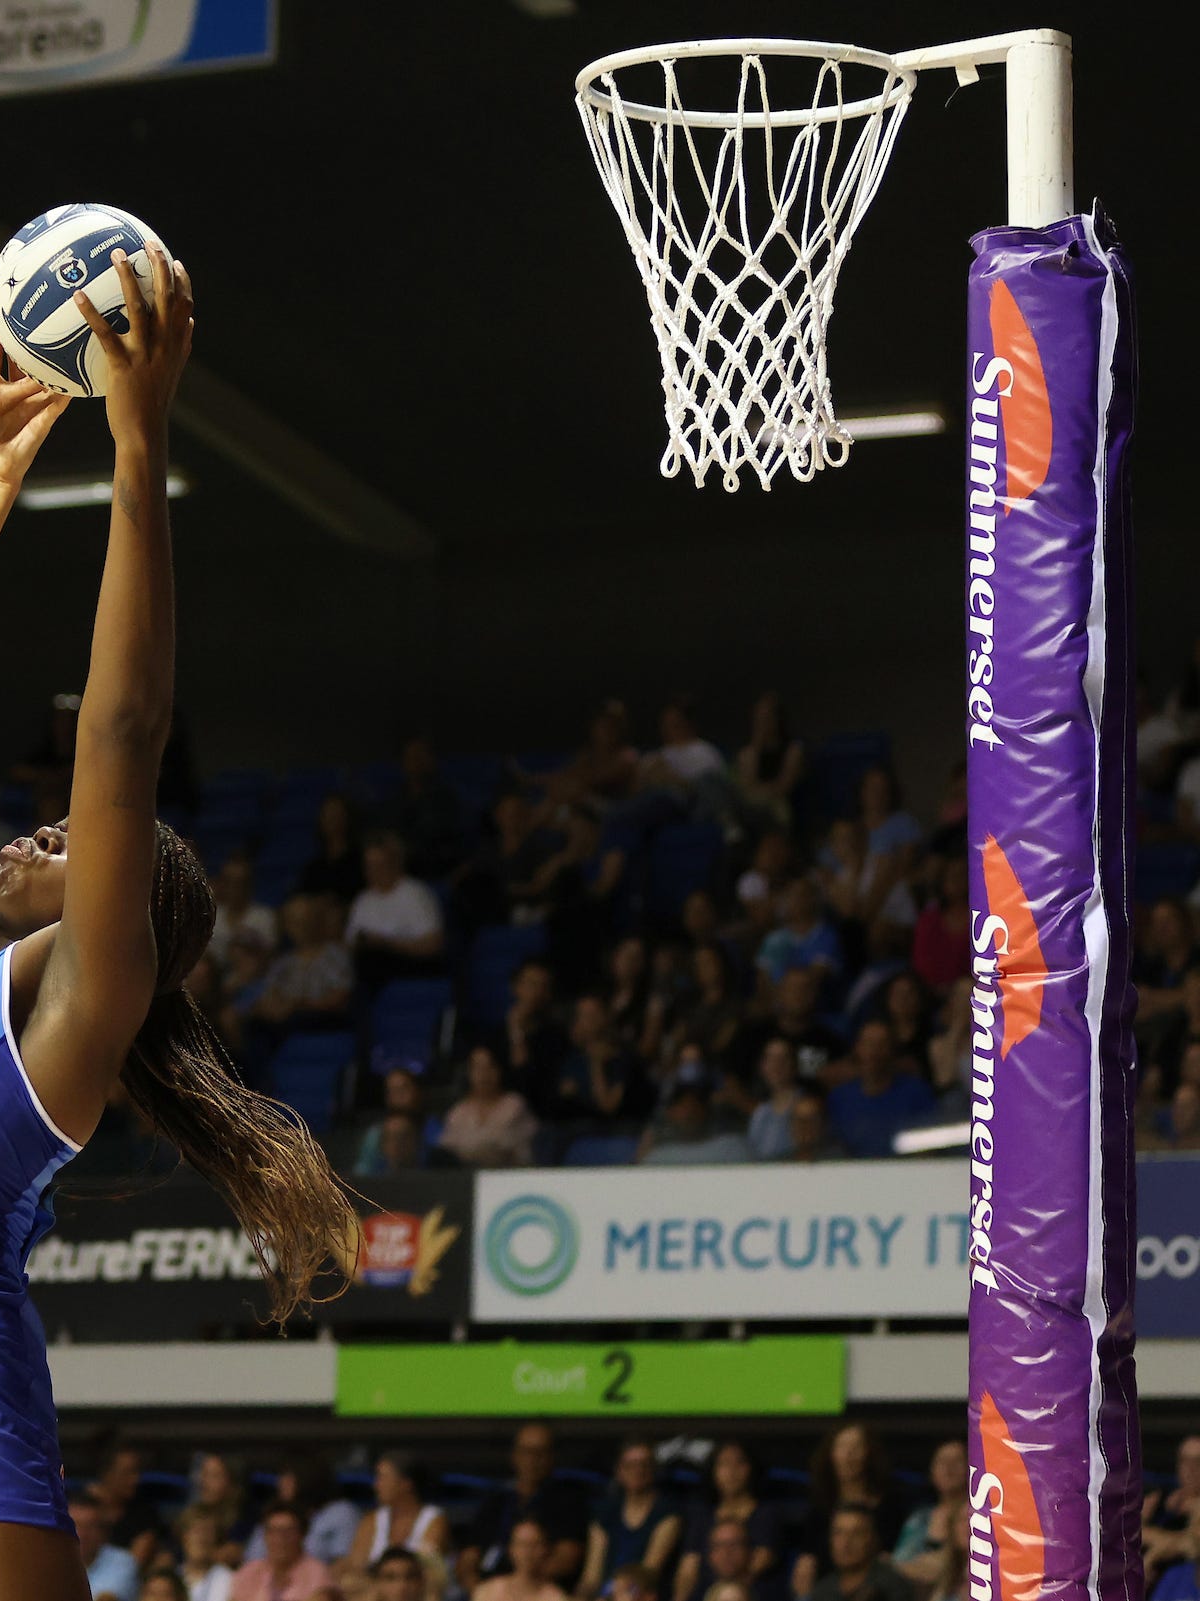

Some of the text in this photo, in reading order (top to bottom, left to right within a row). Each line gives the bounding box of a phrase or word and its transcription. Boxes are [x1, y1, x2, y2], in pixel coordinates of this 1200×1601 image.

[969, 350, 1014, 752] Summerset
[969, 909, 1010, 1296] Summerset
[604, 1214, 904, 1273] MERCURY
[512, 1351, 635, 1404] Court 2
